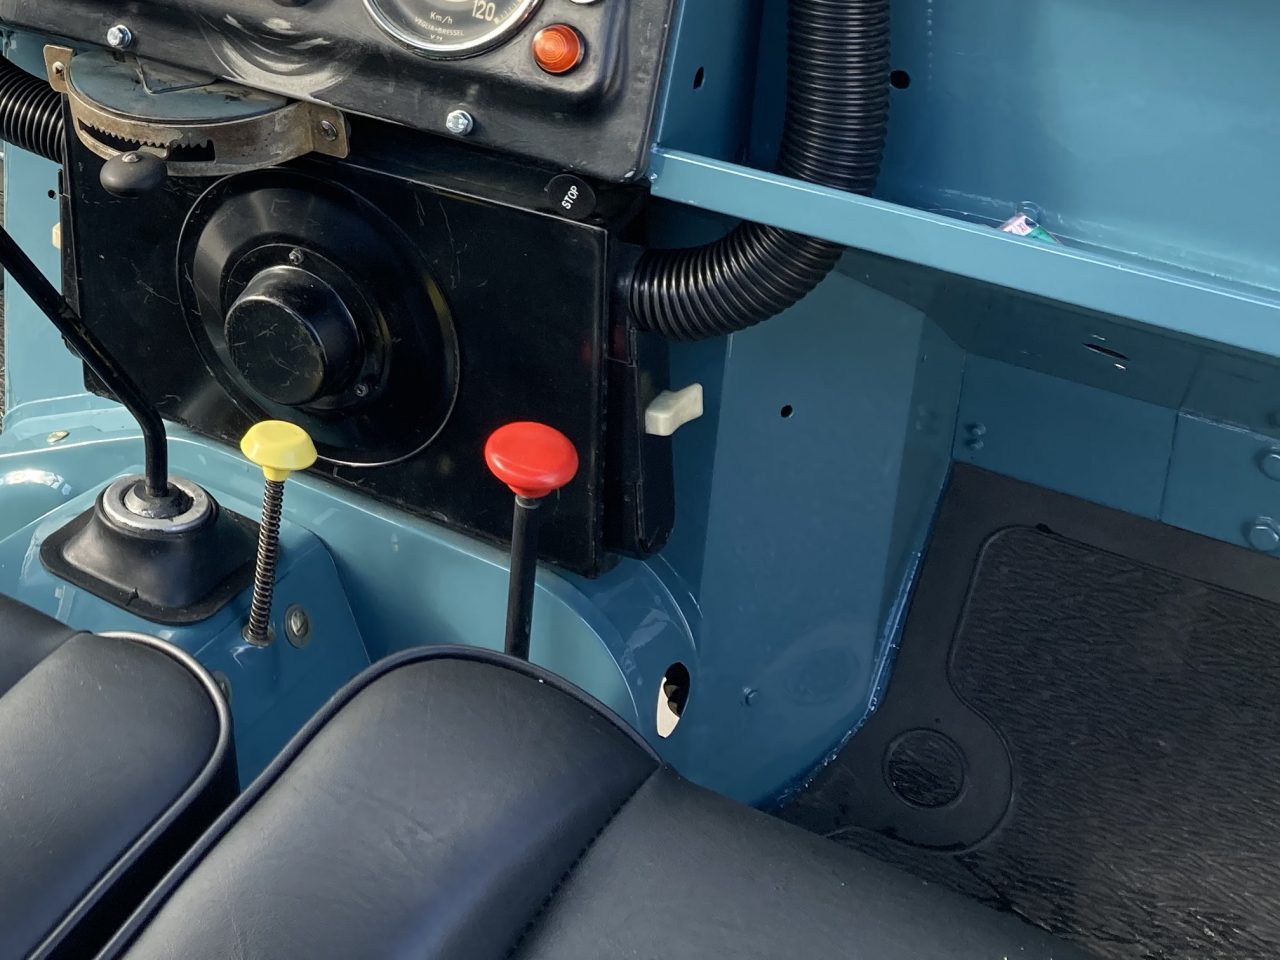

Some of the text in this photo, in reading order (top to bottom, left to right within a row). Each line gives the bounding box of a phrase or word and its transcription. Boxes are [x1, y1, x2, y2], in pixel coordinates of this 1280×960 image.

[430, 11, 453, 24] Km/h
[472, 0, 495, 22] 120
[561, 185, 579, 210] STOP
